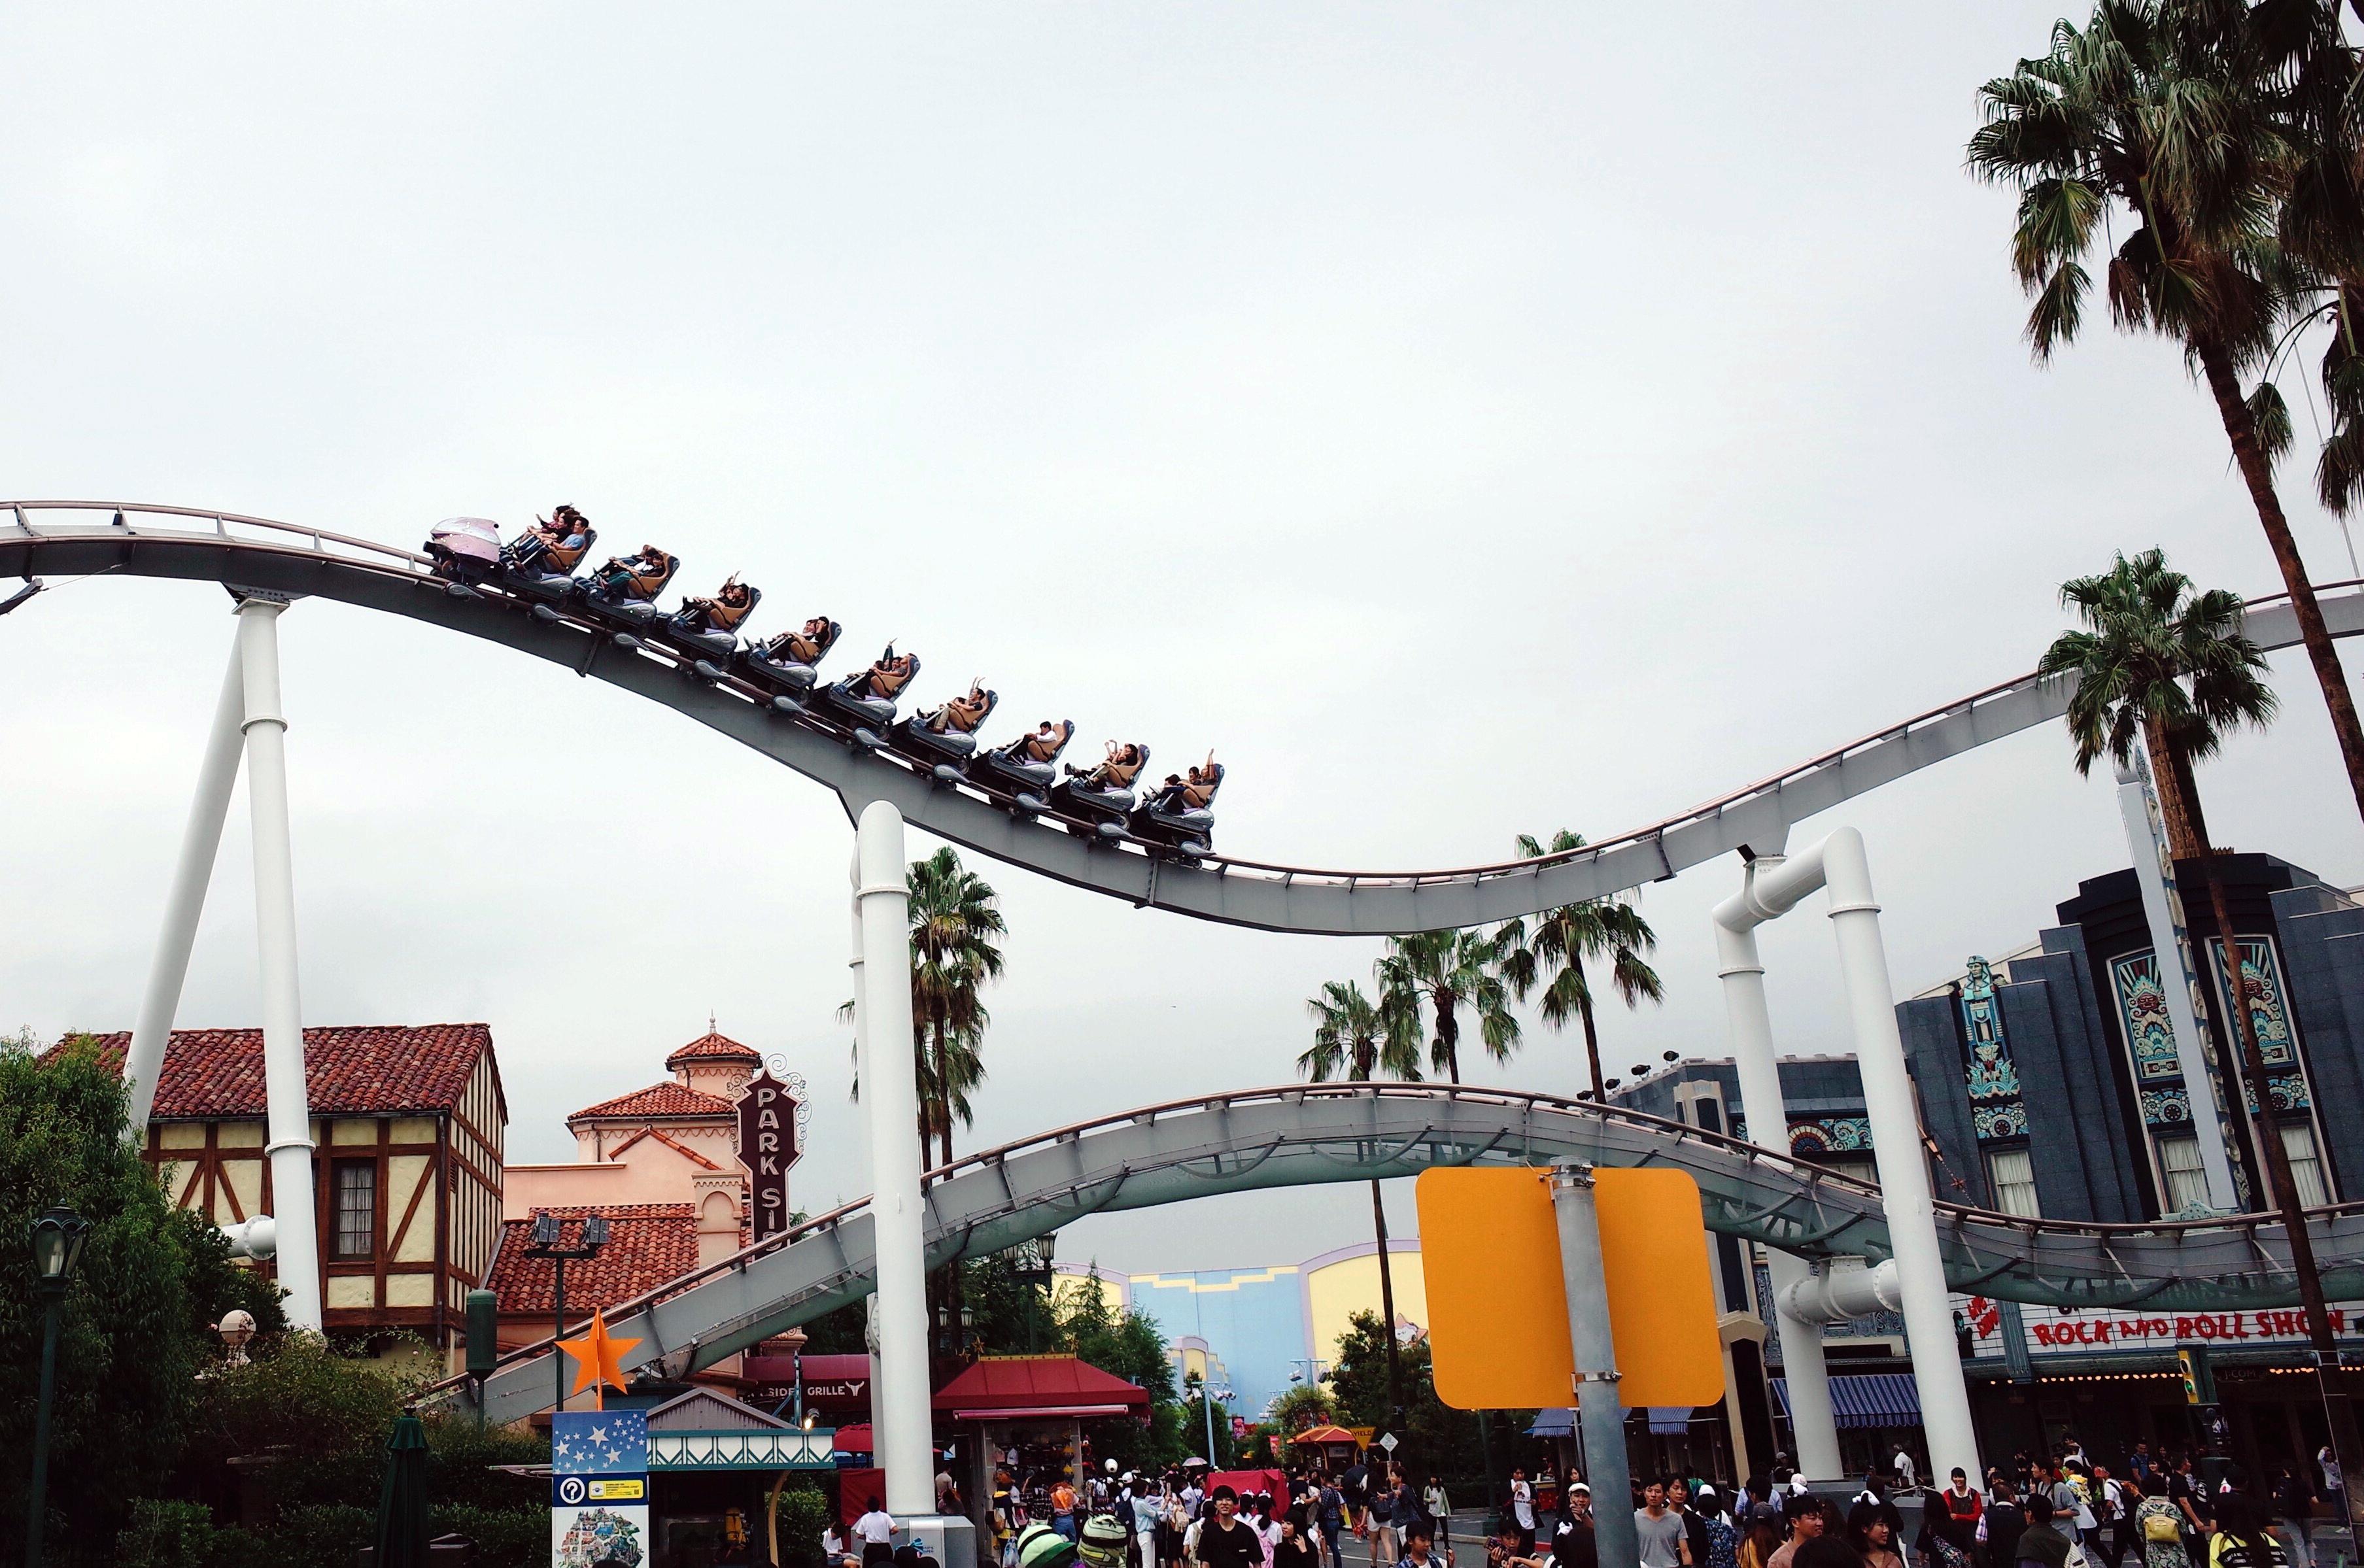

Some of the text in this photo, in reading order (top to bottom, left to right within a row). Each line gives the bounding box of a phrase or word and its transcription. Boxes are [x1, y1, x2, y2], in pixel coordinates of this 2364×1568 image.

[757, 1087, 779, 1175] PARK
[2032, 1320, 2112, 1347] ROCK
[2119, 1318, 2168, 1338] AND
[2176, 1313, 2249, 1339] ROLL
[807, 1386, 846, 1396] GRILLE
